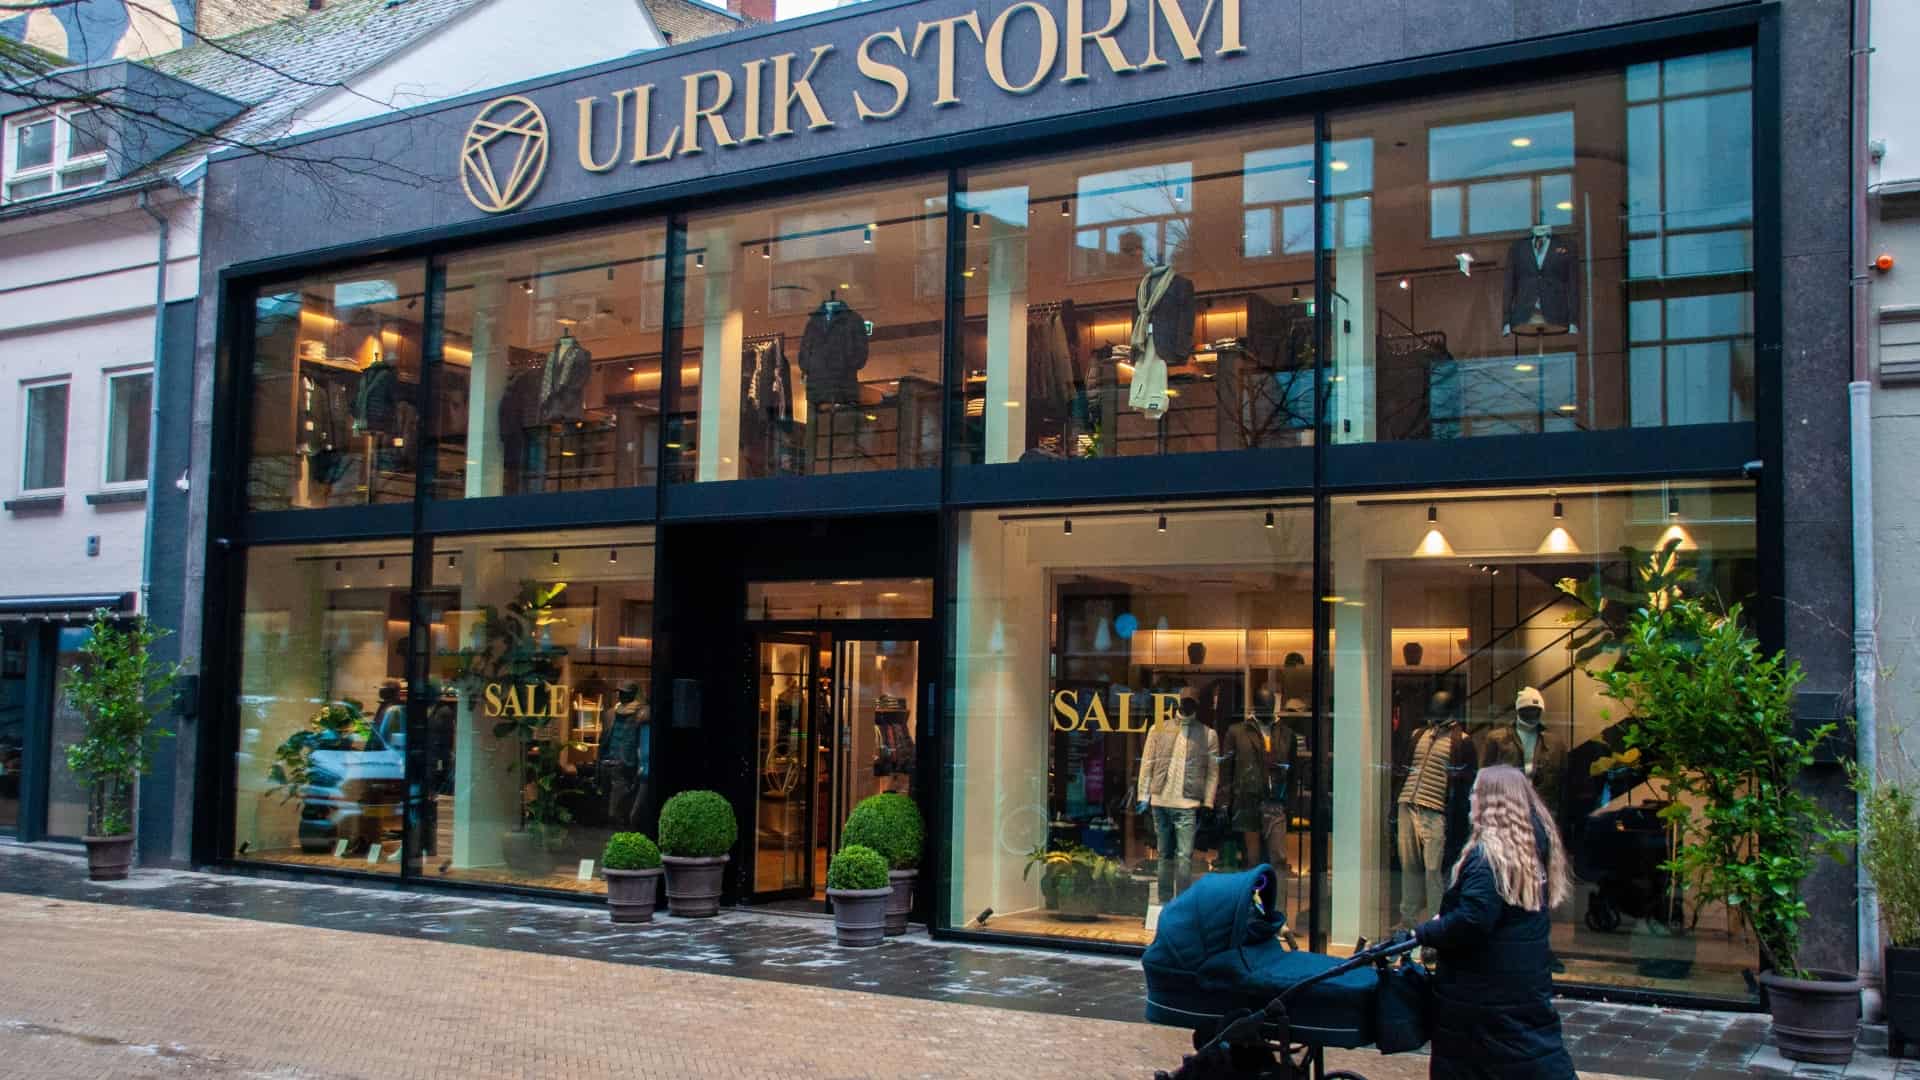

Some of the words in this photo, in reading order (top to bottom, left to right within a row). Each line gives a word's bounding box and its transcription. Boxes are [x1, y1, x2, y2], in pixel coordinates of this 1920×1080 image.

[576, 43, 835, 172] ULRIK
[852, 0, 1247, 120] STORM
[484, 682, 569, 717] SALE
[1053, 689, 1182, 733] SALE
